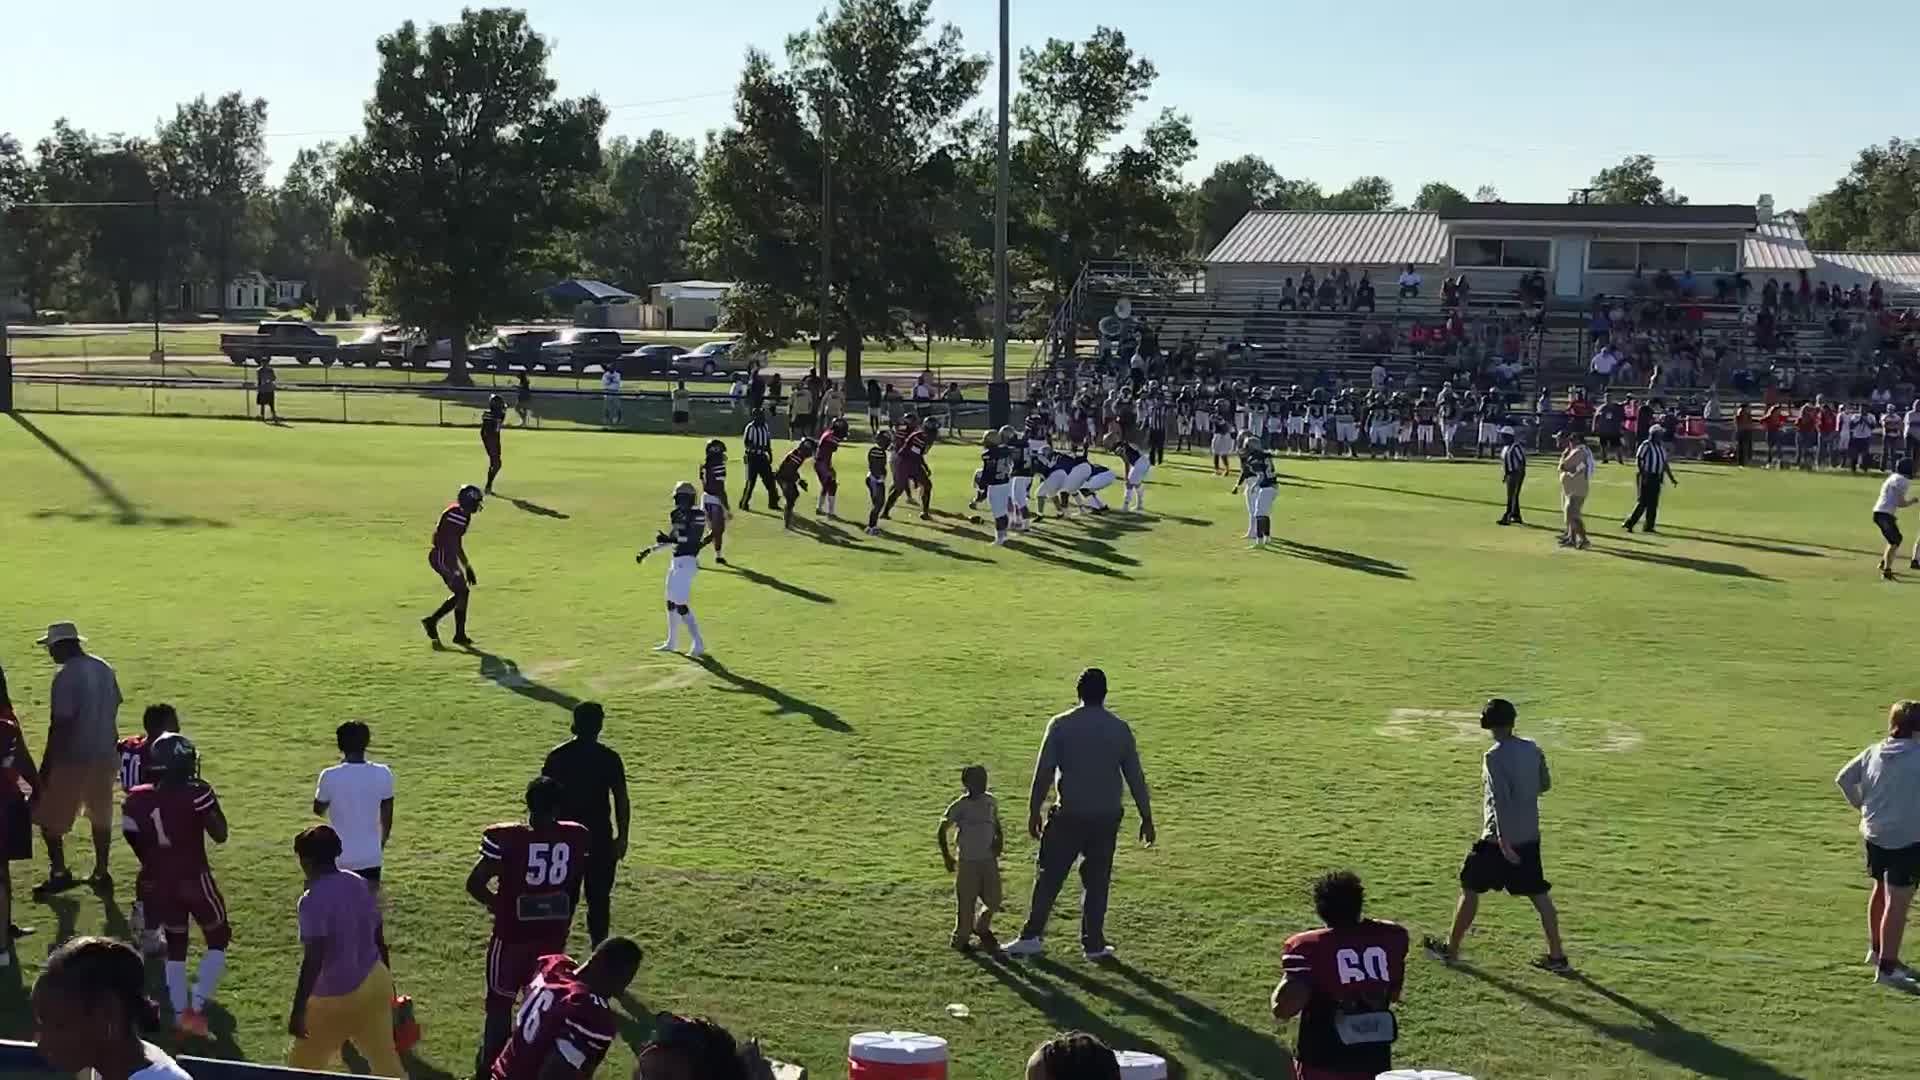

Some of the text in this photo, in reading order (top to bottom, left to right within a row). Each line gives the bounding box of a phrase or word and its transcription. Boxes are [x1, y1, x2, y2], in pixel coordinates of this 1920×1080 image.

[150, 807, 173, 848] 1
[525, 841, 570, 886] 58
[1336, 946, 1390, 985] 60
